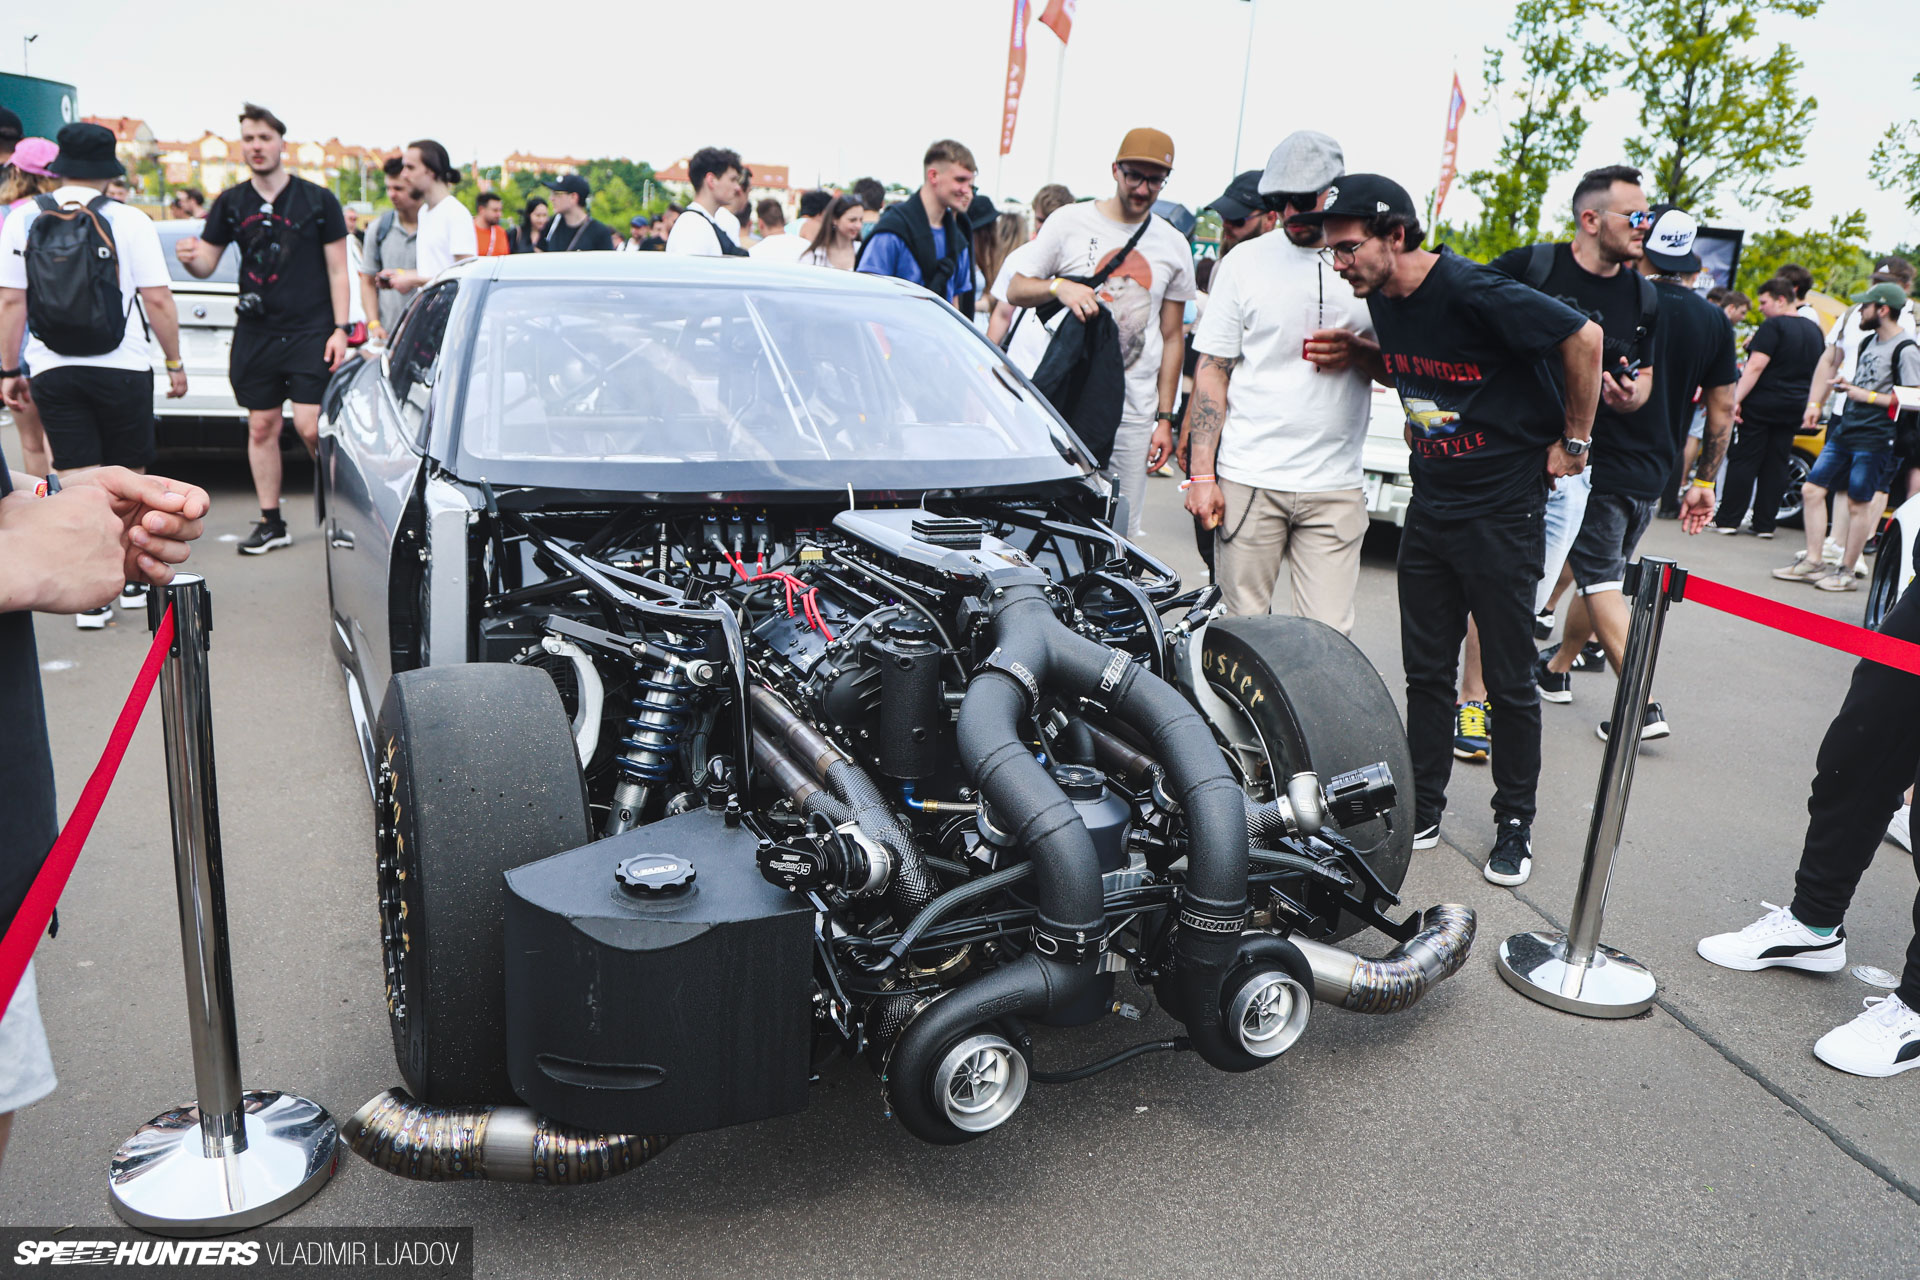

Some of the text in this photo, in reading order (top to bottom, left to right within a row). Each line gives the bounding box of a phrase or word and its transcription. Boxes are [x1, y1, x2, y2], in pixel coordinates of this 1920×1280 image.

[1395, 354, 1411, 373] IN
[1412, 356, 1482, 381] SWEDEN
[794, 862, 811, 875] 45
[1180, 910, 1245, 933] VIBRANT
